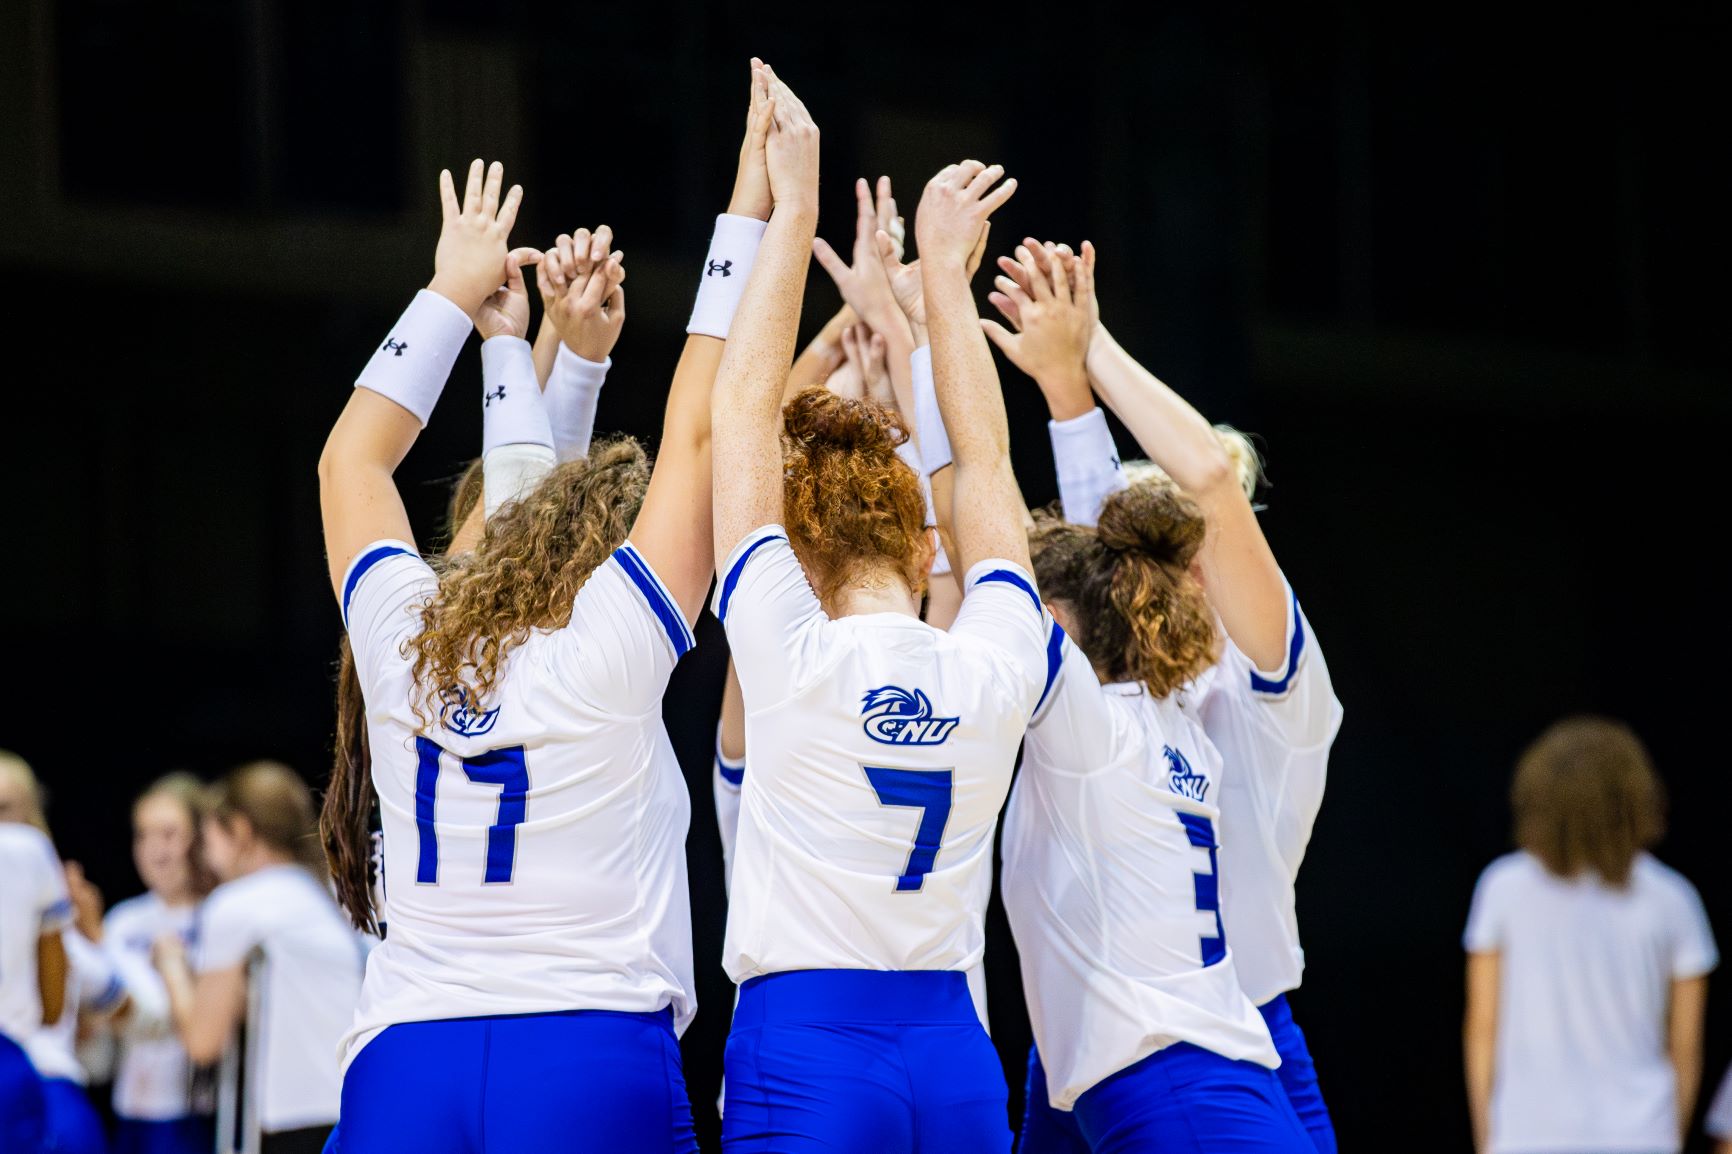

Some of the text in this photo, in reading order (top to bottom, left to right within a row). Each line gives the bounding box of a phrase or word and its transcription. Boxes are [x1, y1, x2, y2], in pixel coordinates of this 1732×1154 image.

[863, 714, 960, 746] CNU
[1168, 770, 1210, 802] CNU
[415, 734, 533, 886] 17
[858, 762, 955, 894] 7
[1174, 809, 1227, 968] 3
